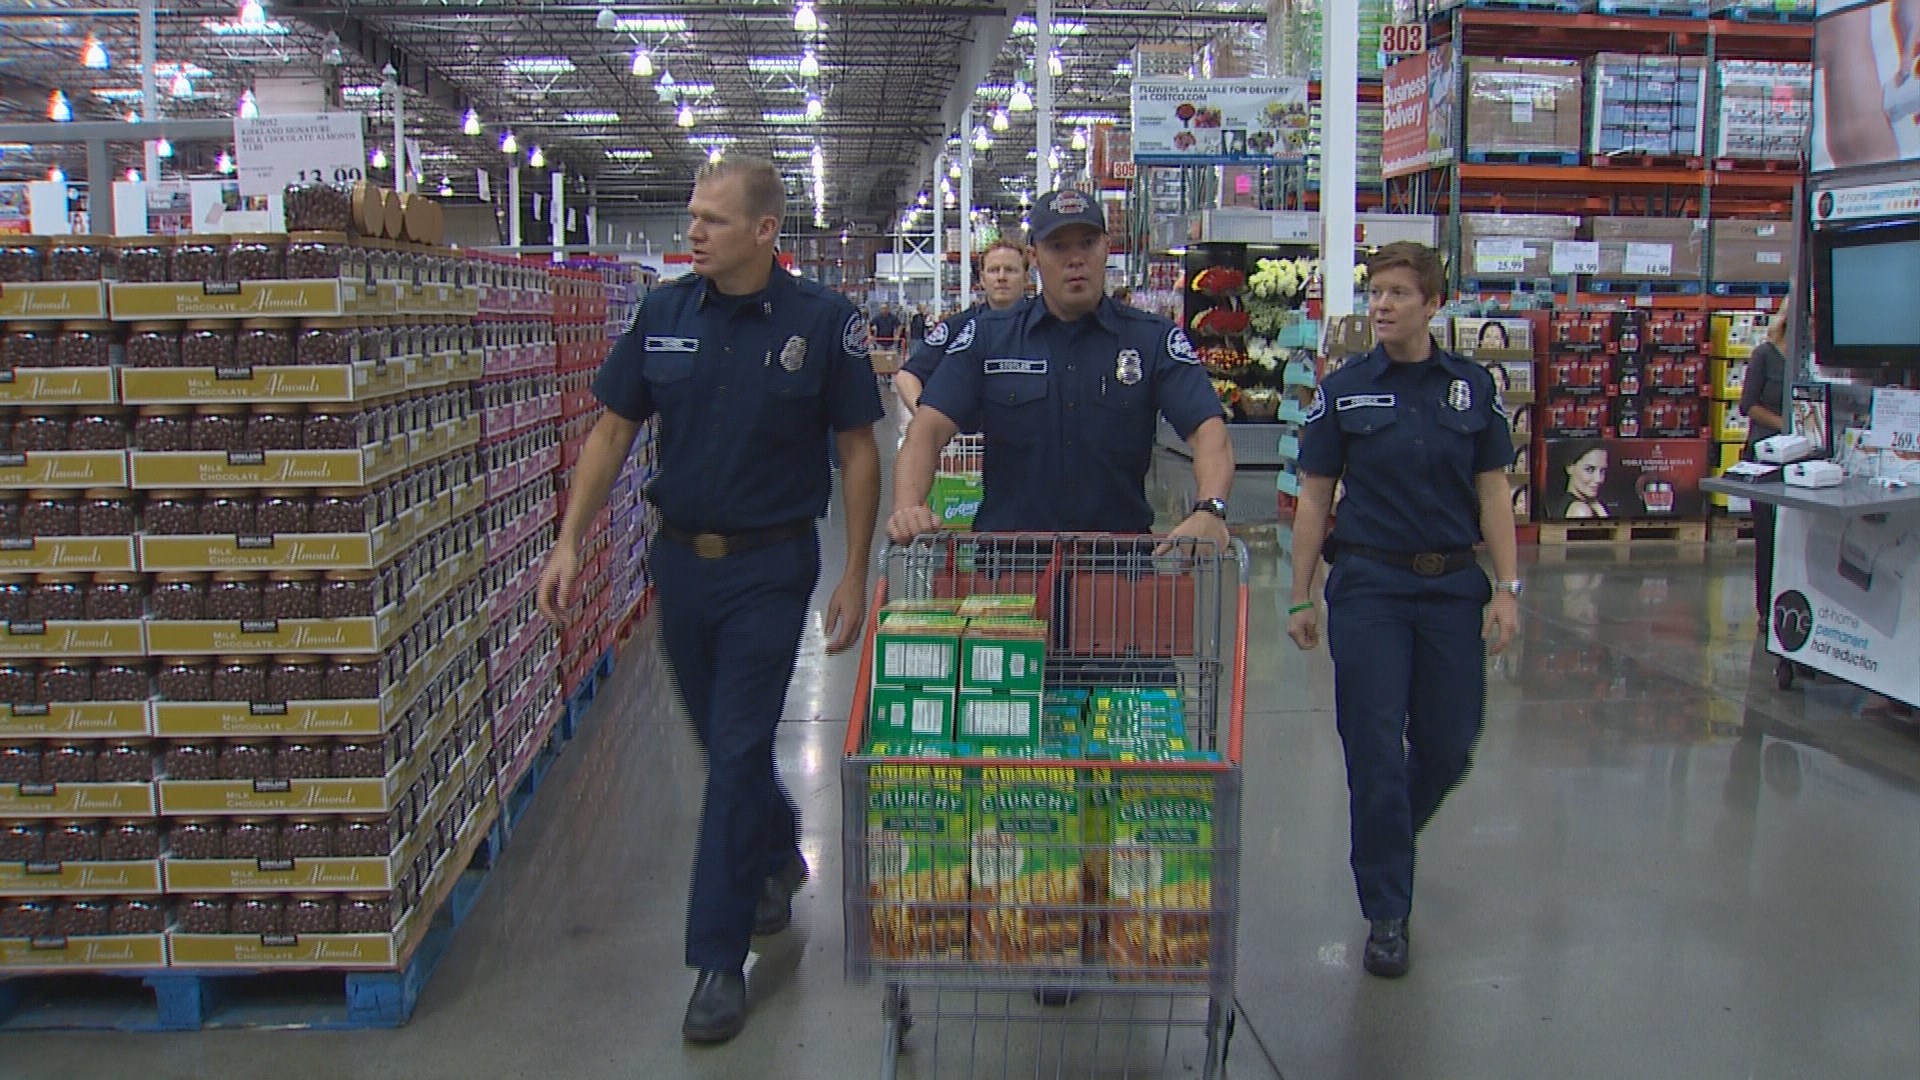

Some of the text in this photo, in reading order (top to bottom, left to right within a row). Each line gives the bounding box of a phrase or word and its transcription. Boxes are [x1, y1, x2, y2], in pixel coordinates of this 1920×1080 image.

[1383, 26, 1422, 52] 303
[1139, 86, 1290, 95] FLOWERS AVAILABLE FOR DELIVERY
[1385, 75, 1427, 106] Business
[1385, 101, 1424, 132] Delivery
[241, 125, 331, 136] KIRKLAND SIGNATURE
[264, 134, 315, 143] CHOCOLATE
[316, 131, 356, 141] ALMONDS
[297, 167, 363, 183] 1399
[1115, 163, 1136, 177] 309
[247, 287, 308, 312] Almonds
[1817, 607, 1859, 630] at-home
[1815, 624, 1869, 650] permanent
[1811, 638, 1879, 673] hair reduction
[869, 790, 962, 811] CRUNCHY
[981, 792, 1074, 811] CRUNCHY
[1119, 801, 1213, 821] CRUNCHY
